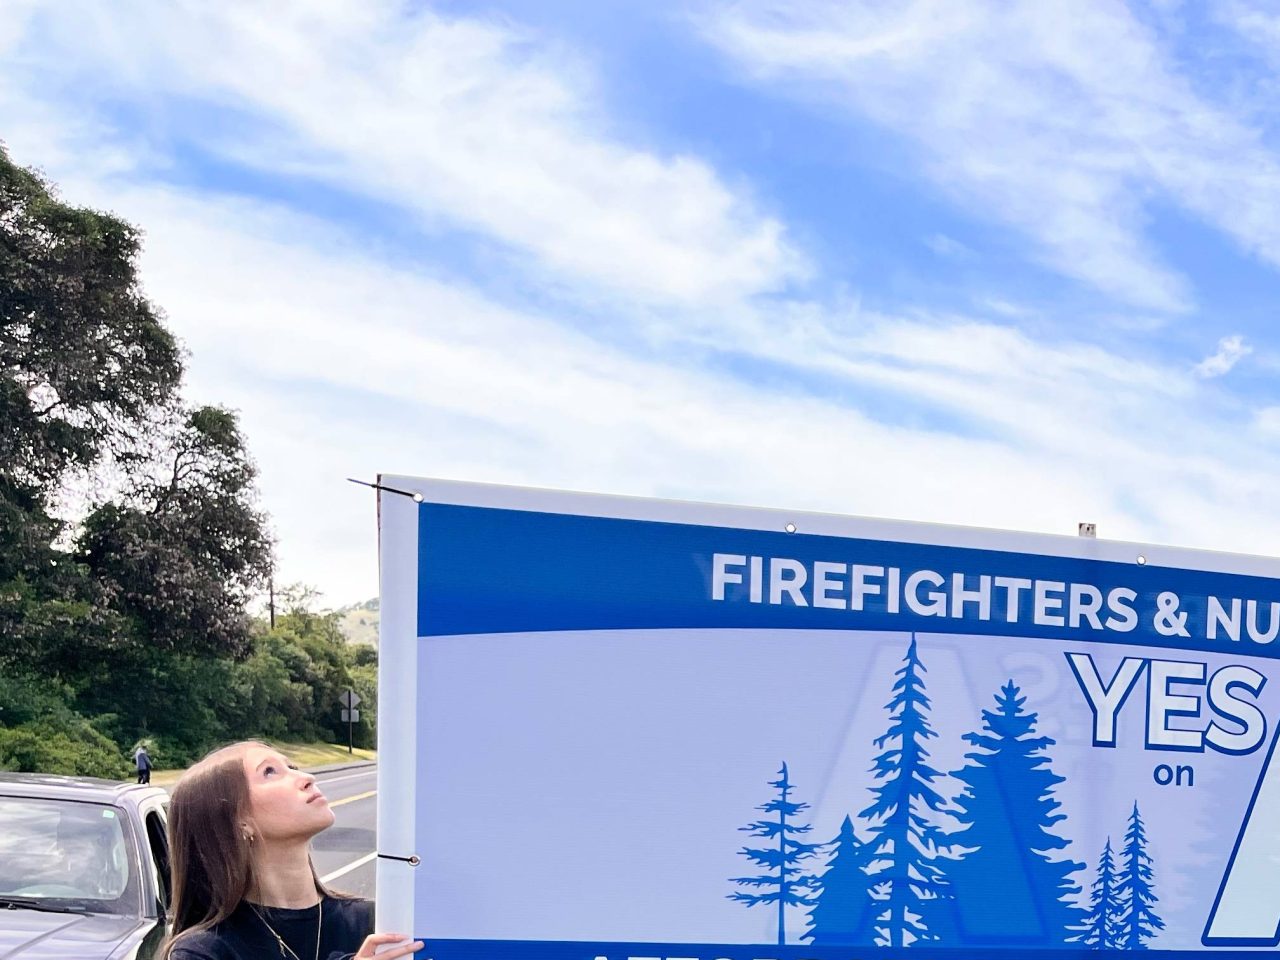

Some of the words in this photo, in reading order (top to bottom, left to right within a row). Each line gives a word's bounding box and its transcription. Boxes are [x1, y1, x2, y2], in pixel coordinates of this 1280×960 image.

[713, 554, 1137, 631] FIREFIGHTERS
[1154, 592, 1190, 637] &
[1064, 652, 1268, 756] YES
[1154, 764, 1193, 786] on
